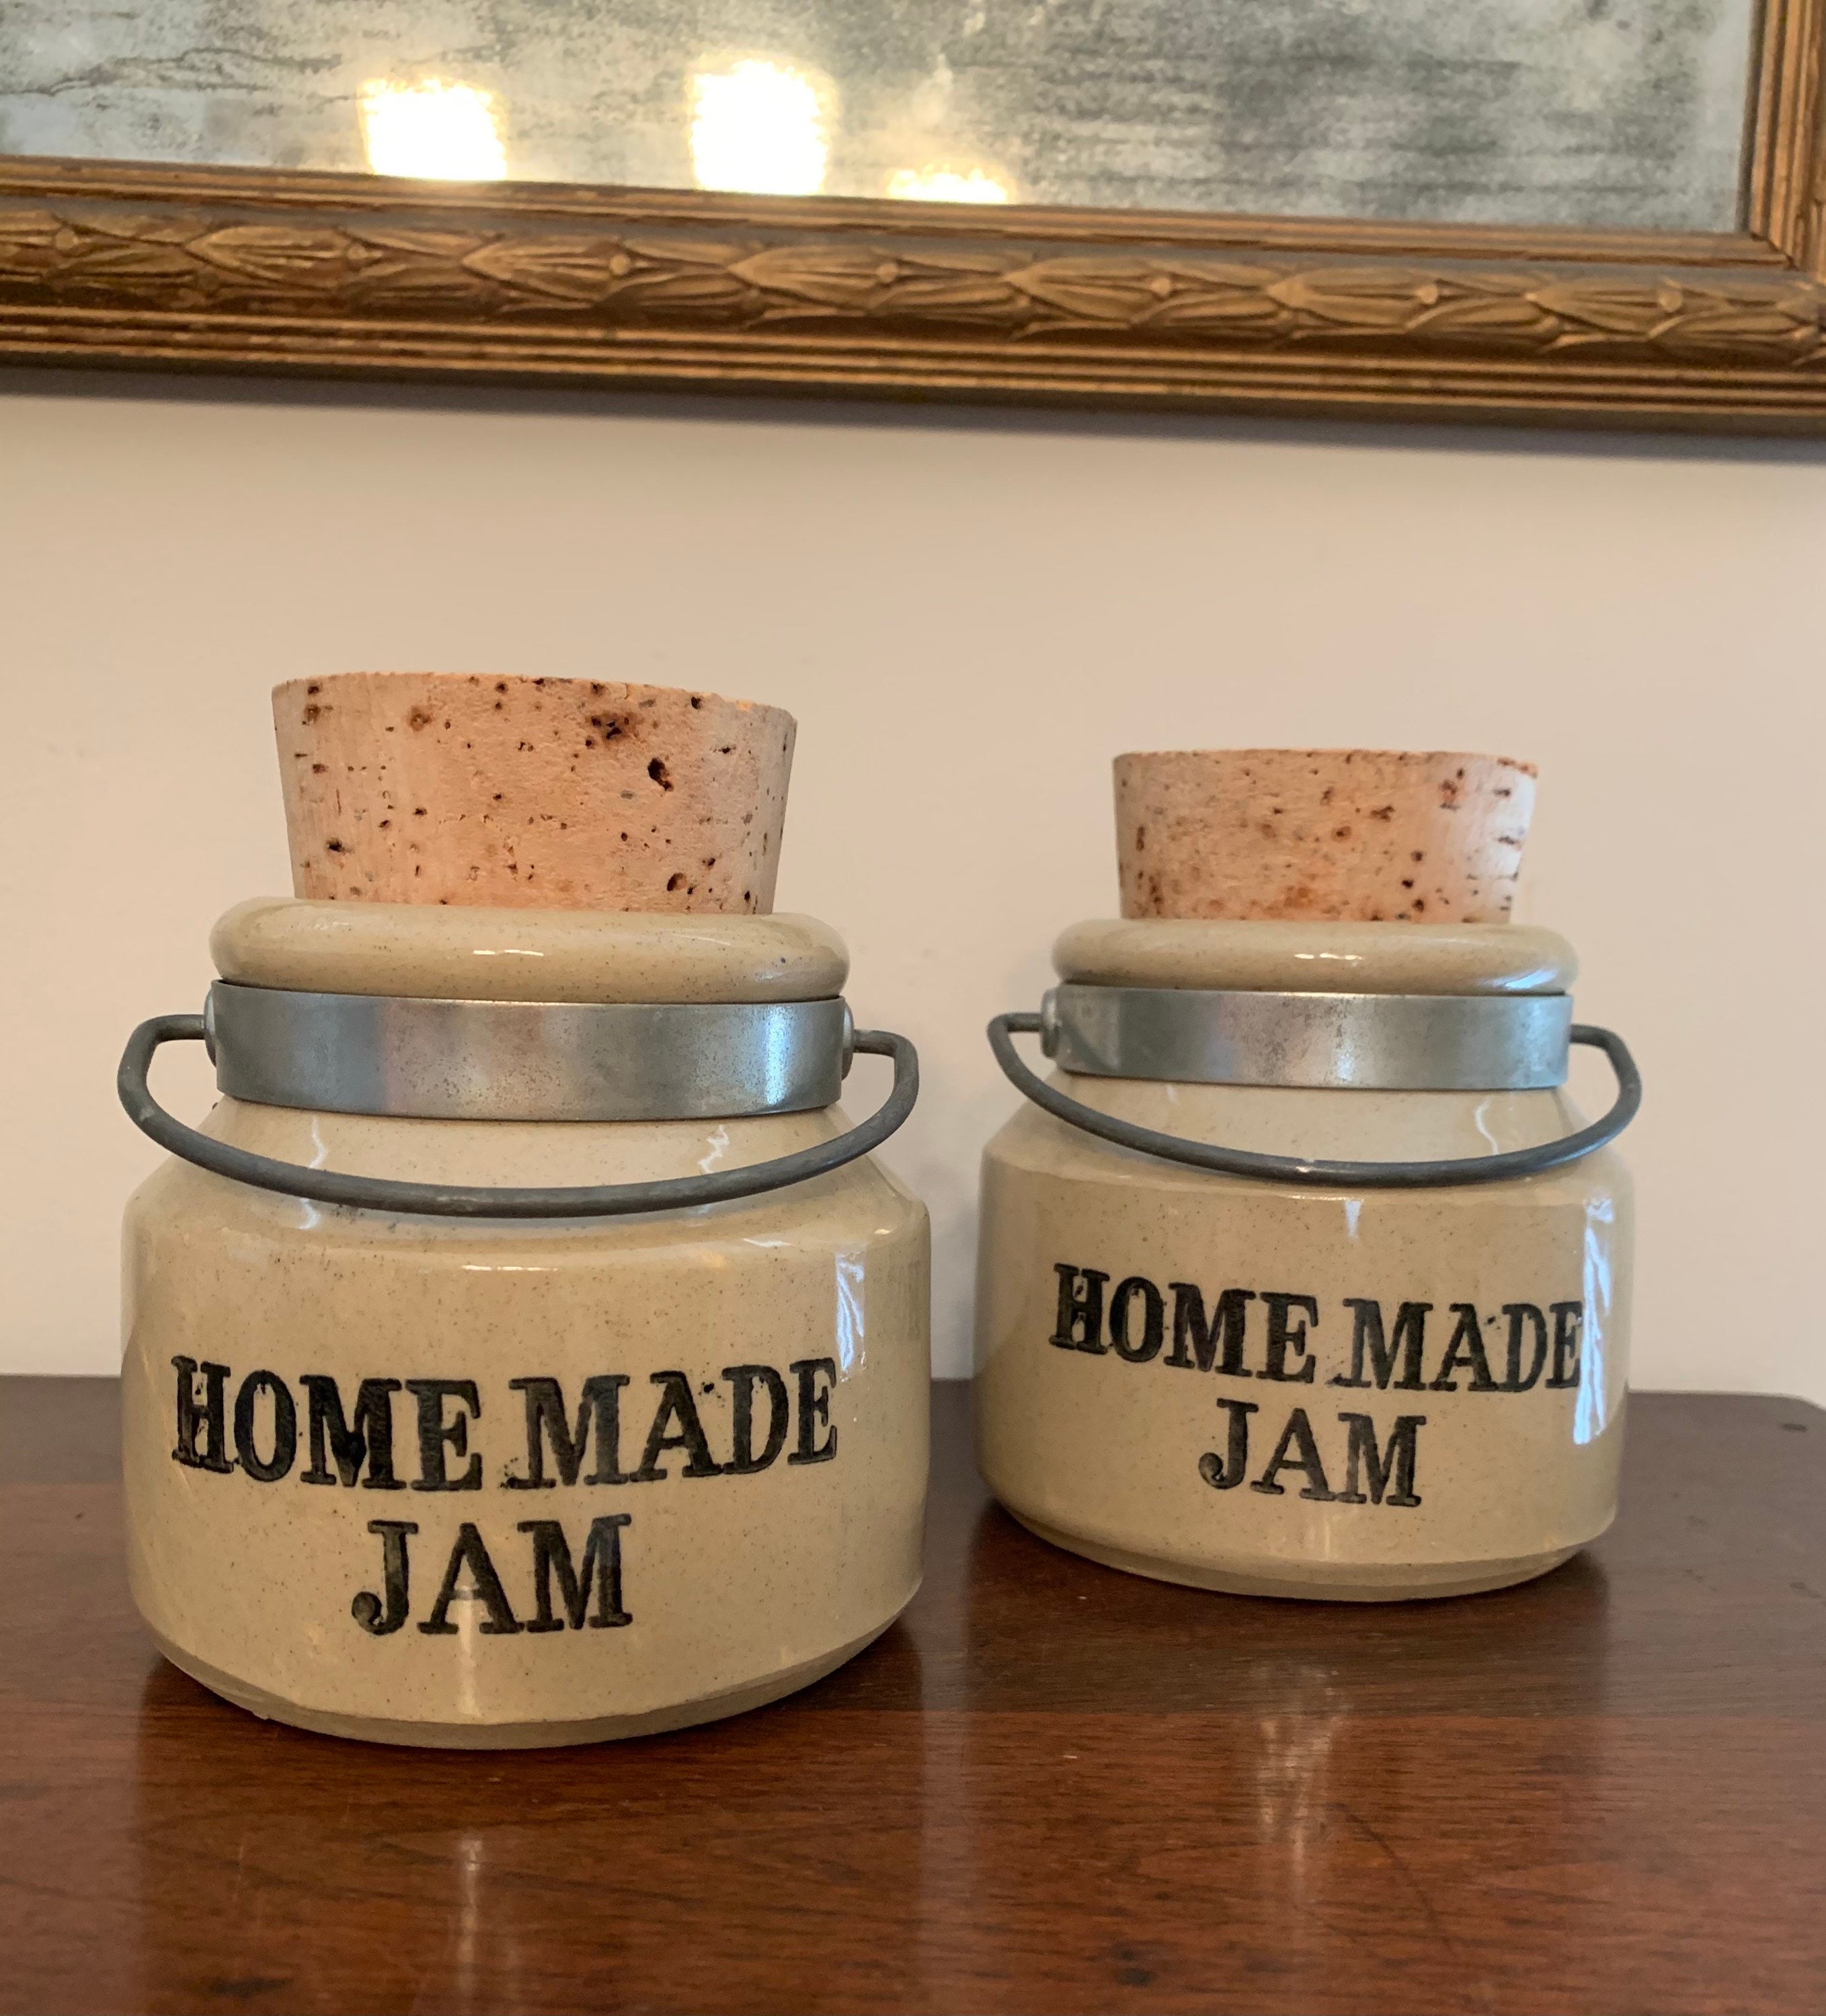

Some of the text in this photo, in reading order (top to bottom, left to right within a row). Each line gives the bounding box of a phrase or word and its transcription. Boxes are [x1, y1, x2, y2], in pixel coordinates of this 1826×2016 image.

[1048, 1262, 1583, 1393] HOME MADE
[171, 1355, 838, 1493] HOME MADE
[1197, 1397, 1427, 1508] JAM
[350, 1513, 634, 1637] JAM
